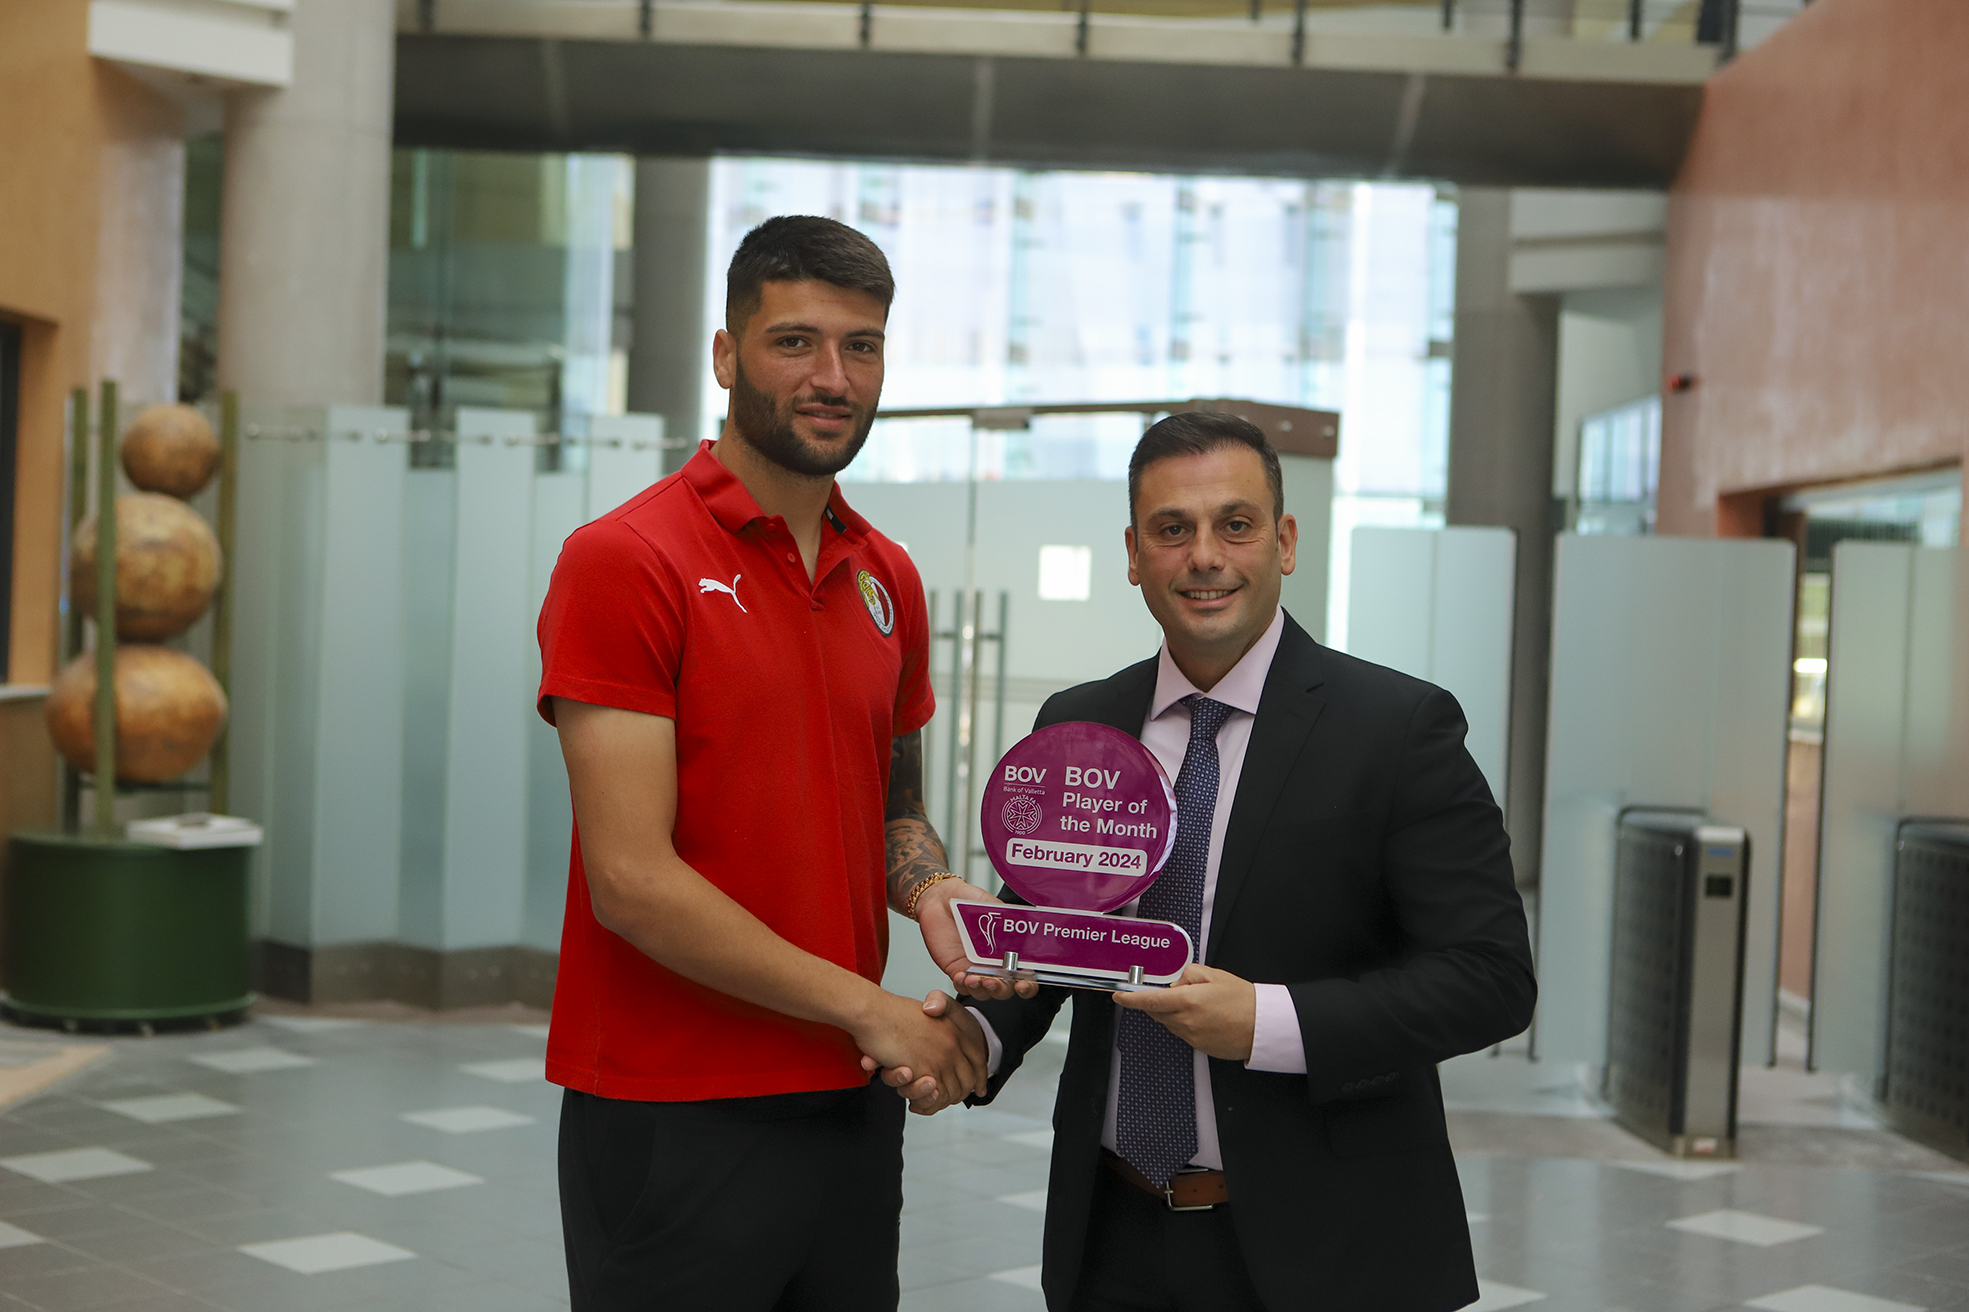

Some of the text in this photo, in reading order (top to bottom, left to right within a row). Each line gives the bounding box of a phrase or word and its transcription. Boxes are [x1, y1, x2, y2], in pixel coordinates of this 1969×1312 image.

[1004, 765, 1047, 784] BOV
[1065, 766, 1121, 790] BOV
[1010, 794, 1029, 802] MALTA
[1062, 792, 1148, 814] Player of
[1060, 815, 1157, 839] the Month
[1011, 843, 1142, 870] February 2024
[1003, 918, 1171, 949] BOV Premier League
